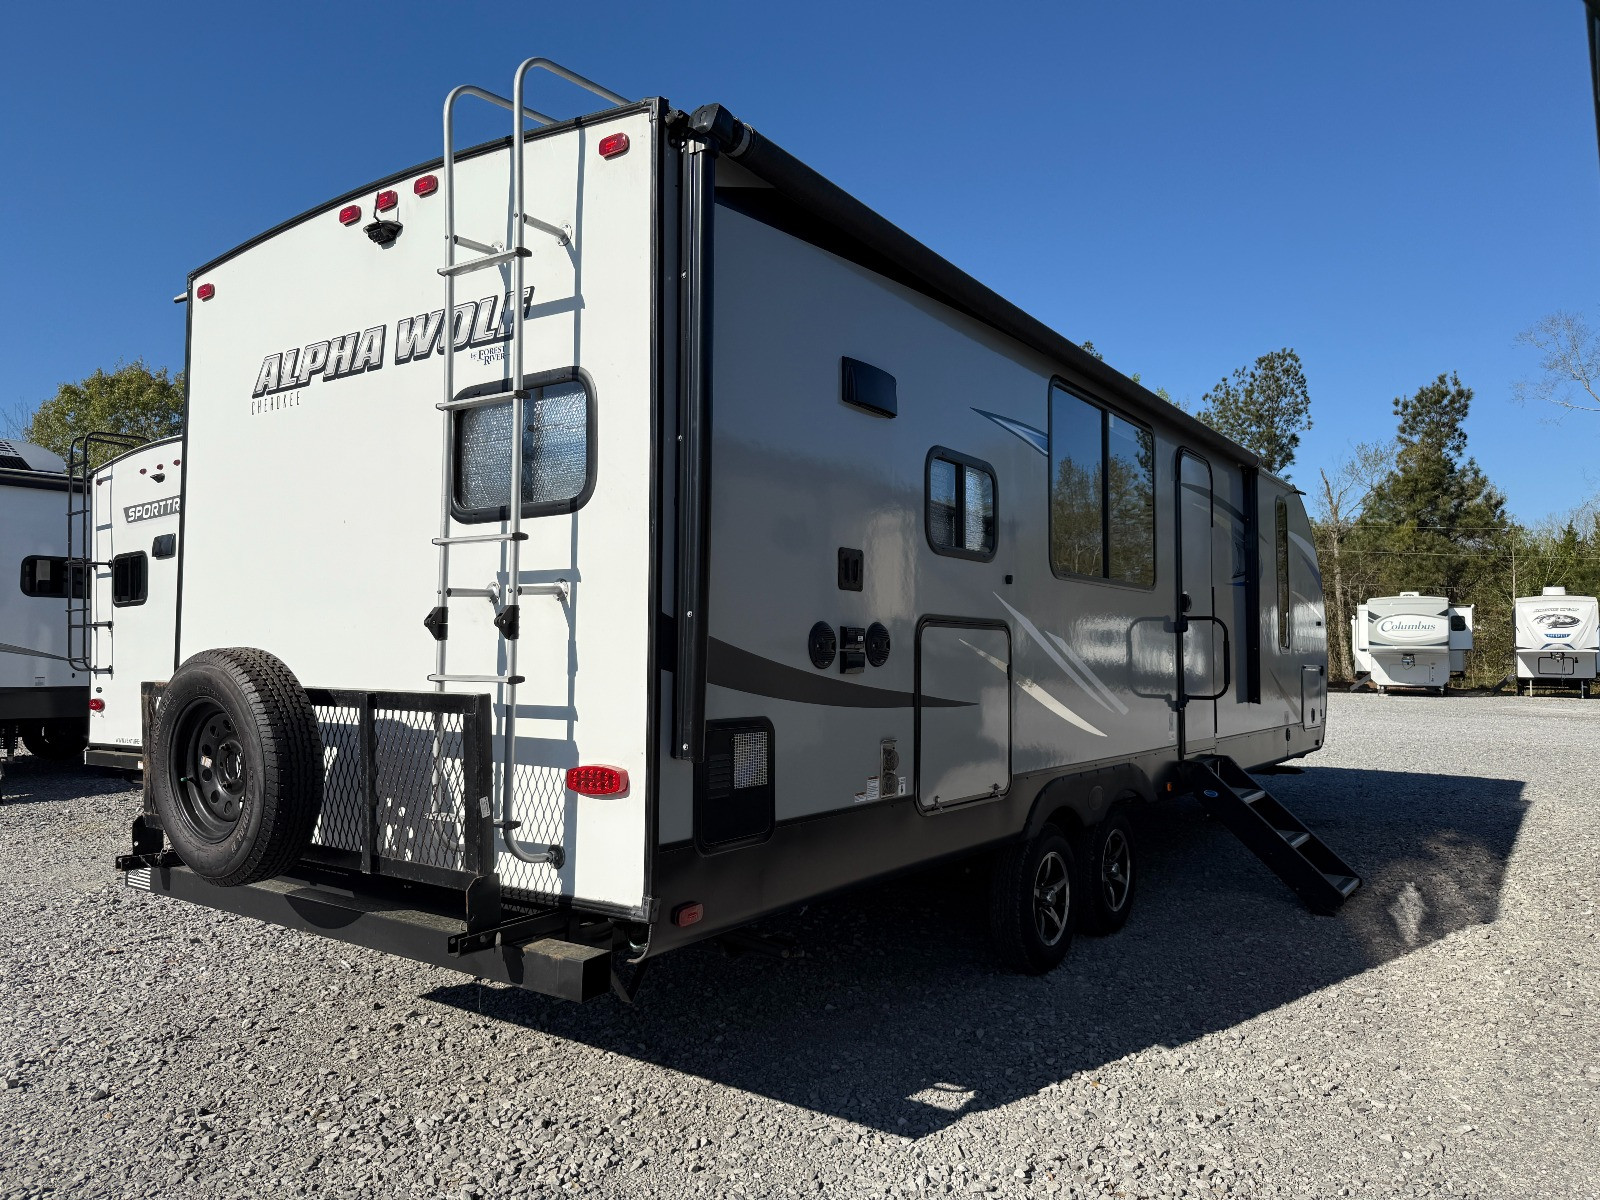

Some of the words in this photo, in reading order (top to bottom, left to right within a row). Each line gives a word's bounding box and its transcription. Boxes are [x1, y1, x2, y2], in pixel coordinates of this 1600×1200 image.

[252, 324, 387, 398] ALPHA
[395, 286, 535, 365] WOLF
[477, 346, 506, 361] FOREST
[483, 352, 507, 366] RIVER
[251, 390, 300, 415] CHEROKEE
[1380, 620, 1436, 632] Columbus
